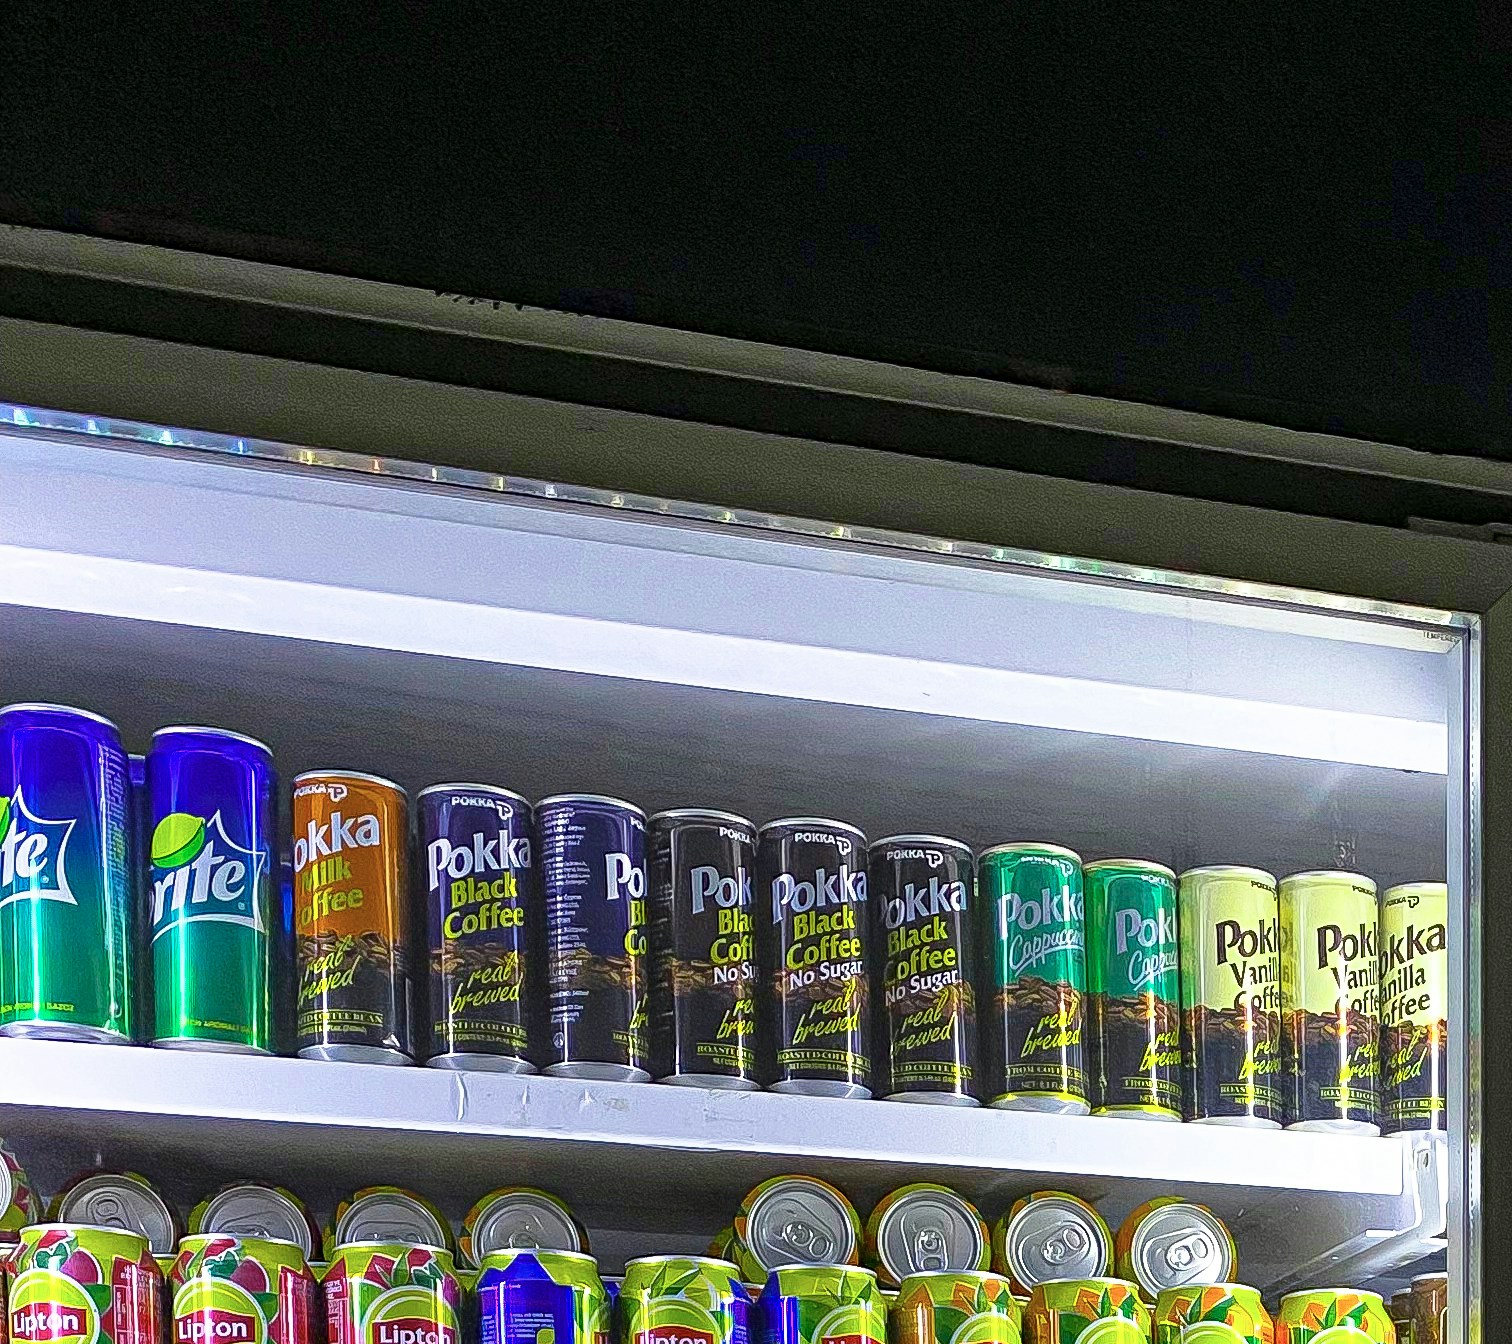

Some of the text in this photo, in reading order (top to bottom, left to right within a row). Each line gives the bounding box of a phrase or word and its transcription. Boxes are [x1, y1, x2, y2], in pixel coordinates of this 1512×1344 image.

[452, 797, 494, 808] POKKA
[795, 833, 834, 844] POKKA
[887, 850, 923, 860] POKKA
[428, 830, 531, 892] Pokka
[451, 872, 517, 909] Black
[772, 864, 867, 924] Pokka
[444, 903, 524, 939] Coffee
[793, 905, 855, 941] Black
[888, 916, 948, 957] Black
[467, 950, 517, 988] real
[786, 934, 860, 970] Coffee
[450, 972, 523, 1014] brewed
[713, 966, 737, 985] No
[790, 961, 862, 989] No Sugar
[886, 970, 957, 1006] No Sugar
[793, 1003, 860, 1044] brewed
[13, 1312, 78, 1336] Lipton
[178, 1318, 247, 1342] Lipton
